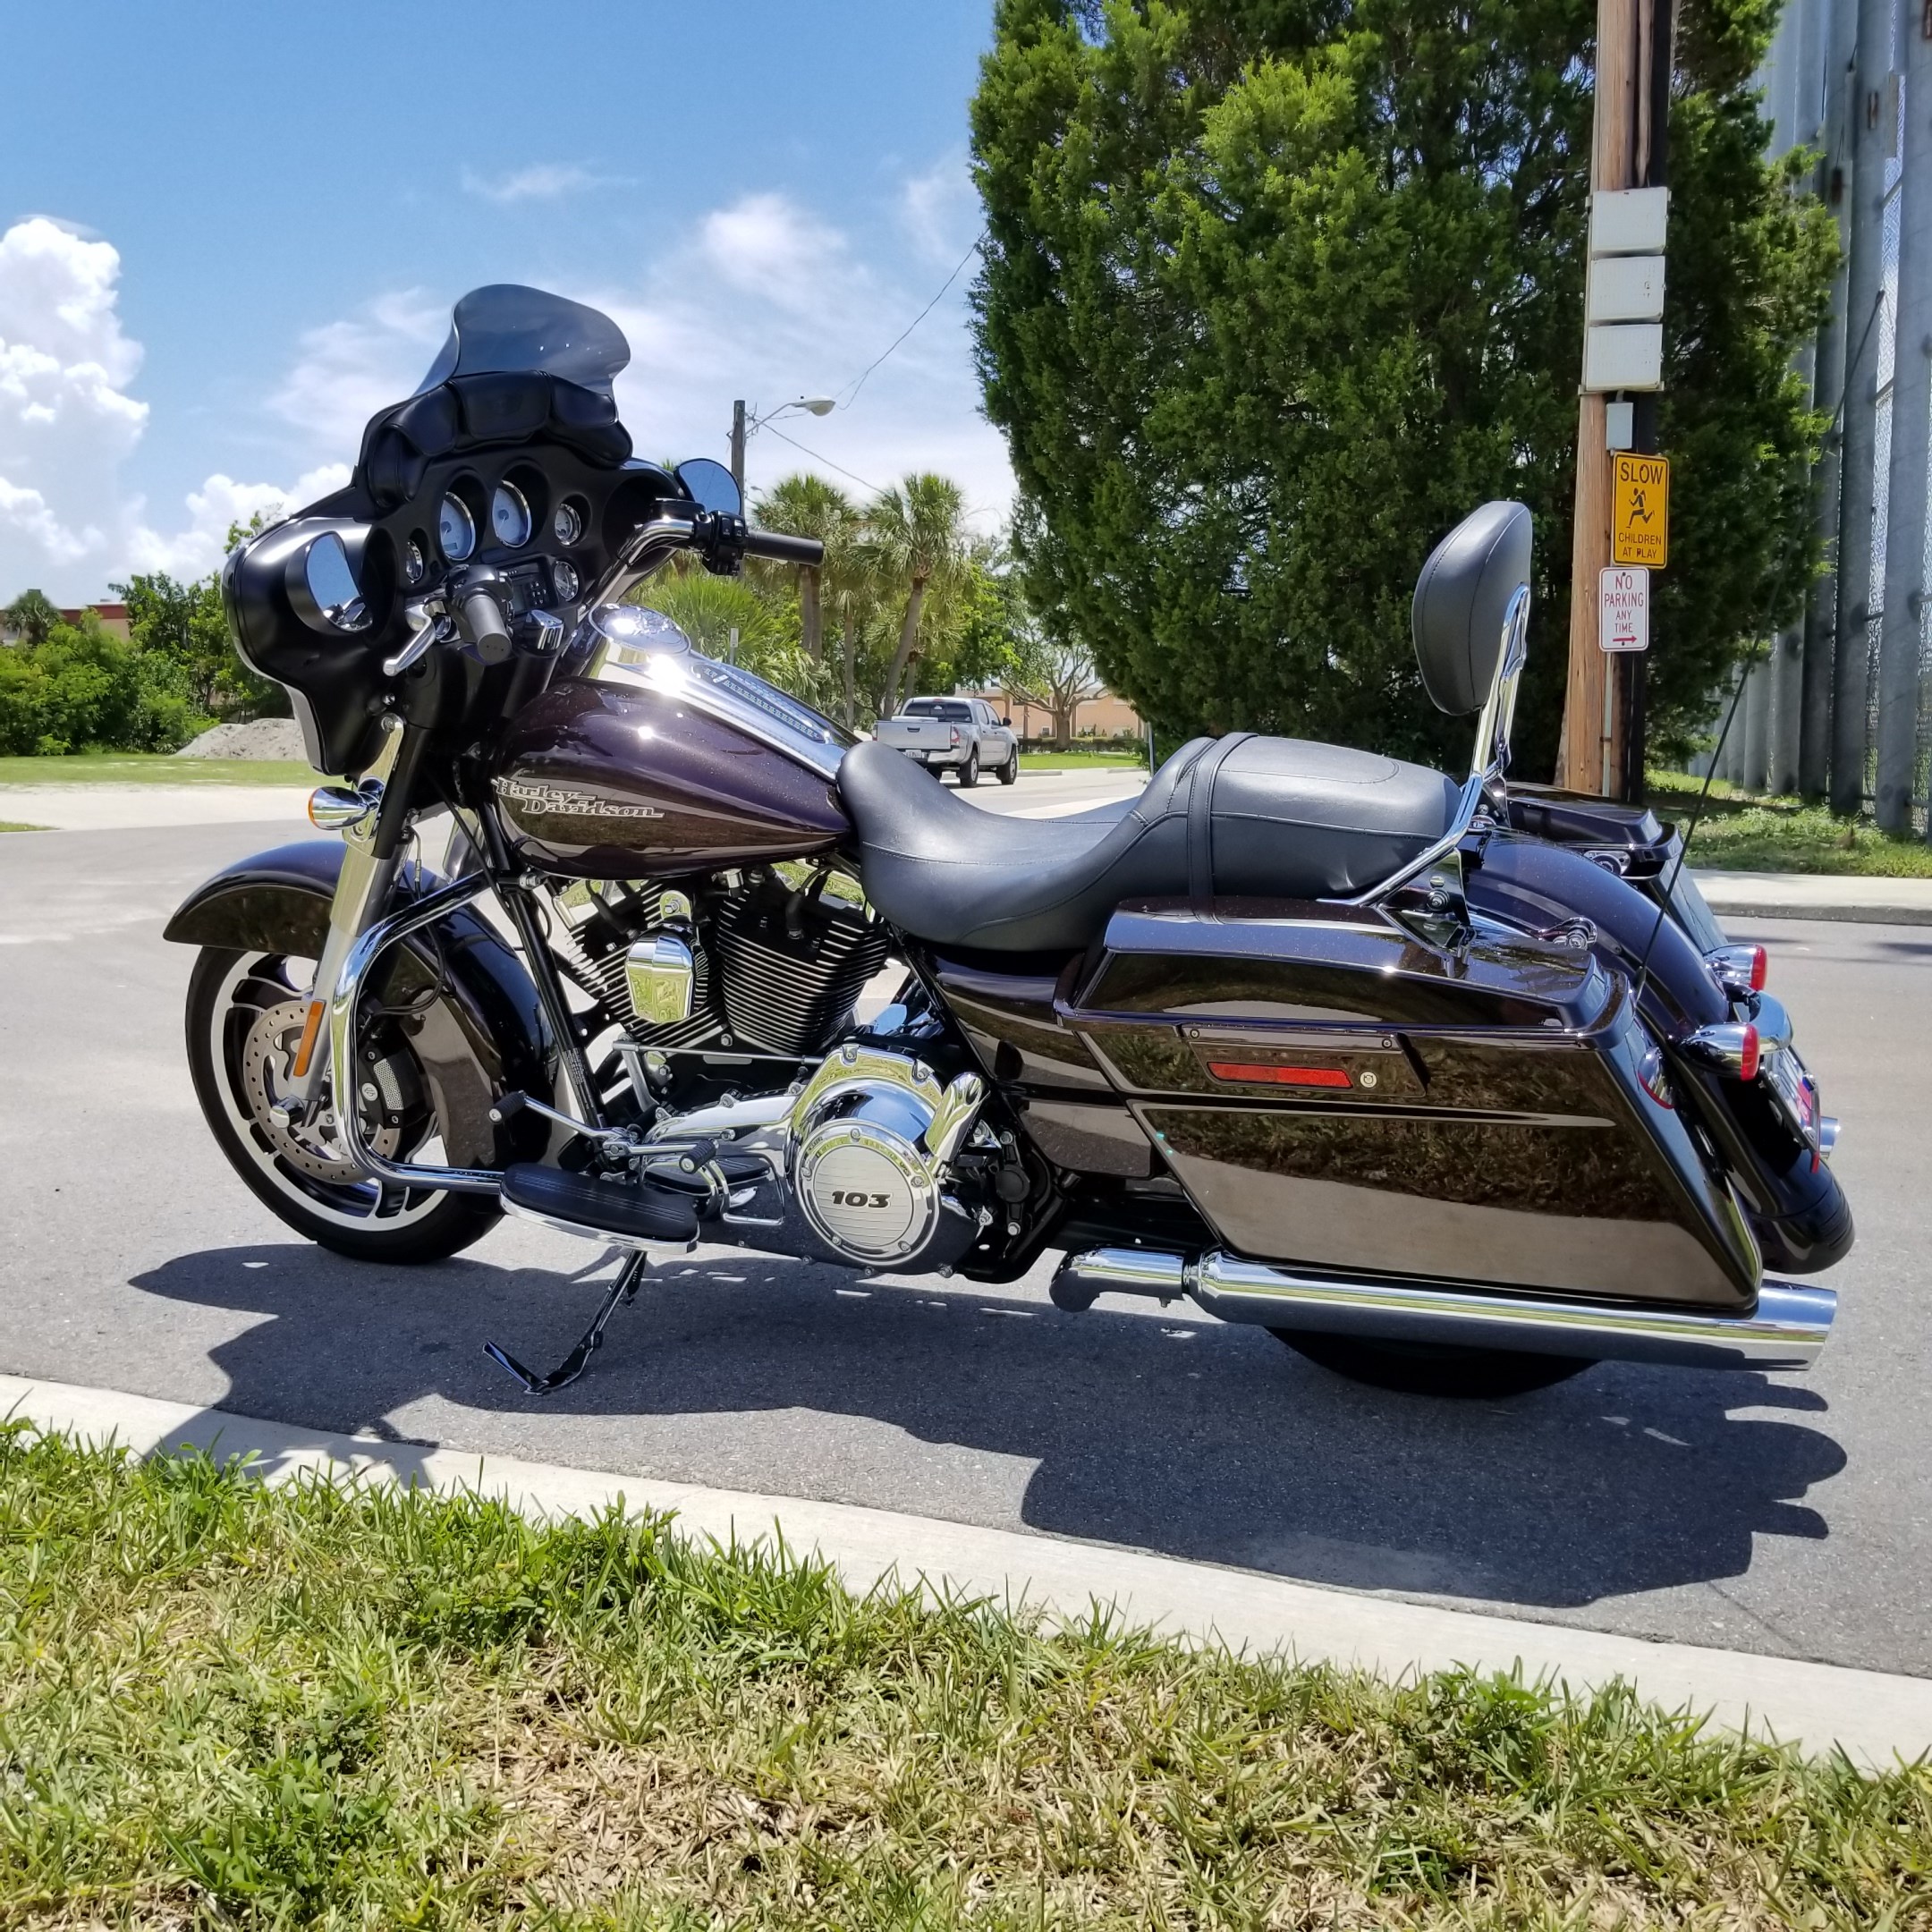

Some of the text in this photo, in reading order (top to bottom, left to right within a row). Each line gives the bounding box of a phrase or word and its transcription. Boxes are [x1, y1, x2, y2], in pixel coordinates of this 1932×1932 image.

[1620, 461, 1664, 485] SLOW
[1618, 532, 1662, 546] CHILDREN
[1623, 547, 1657, 559] AT PLAY
[1615, 575, 1633, 590] NO
[1604, 592, 1644, 607] PARKING
[1615, 610, 1632, 621] ANY
[1614, 623, 1633, 633] TIME
[521, 798, 665, 818] Davidson
[831, 1191, 893, 1208] 103
